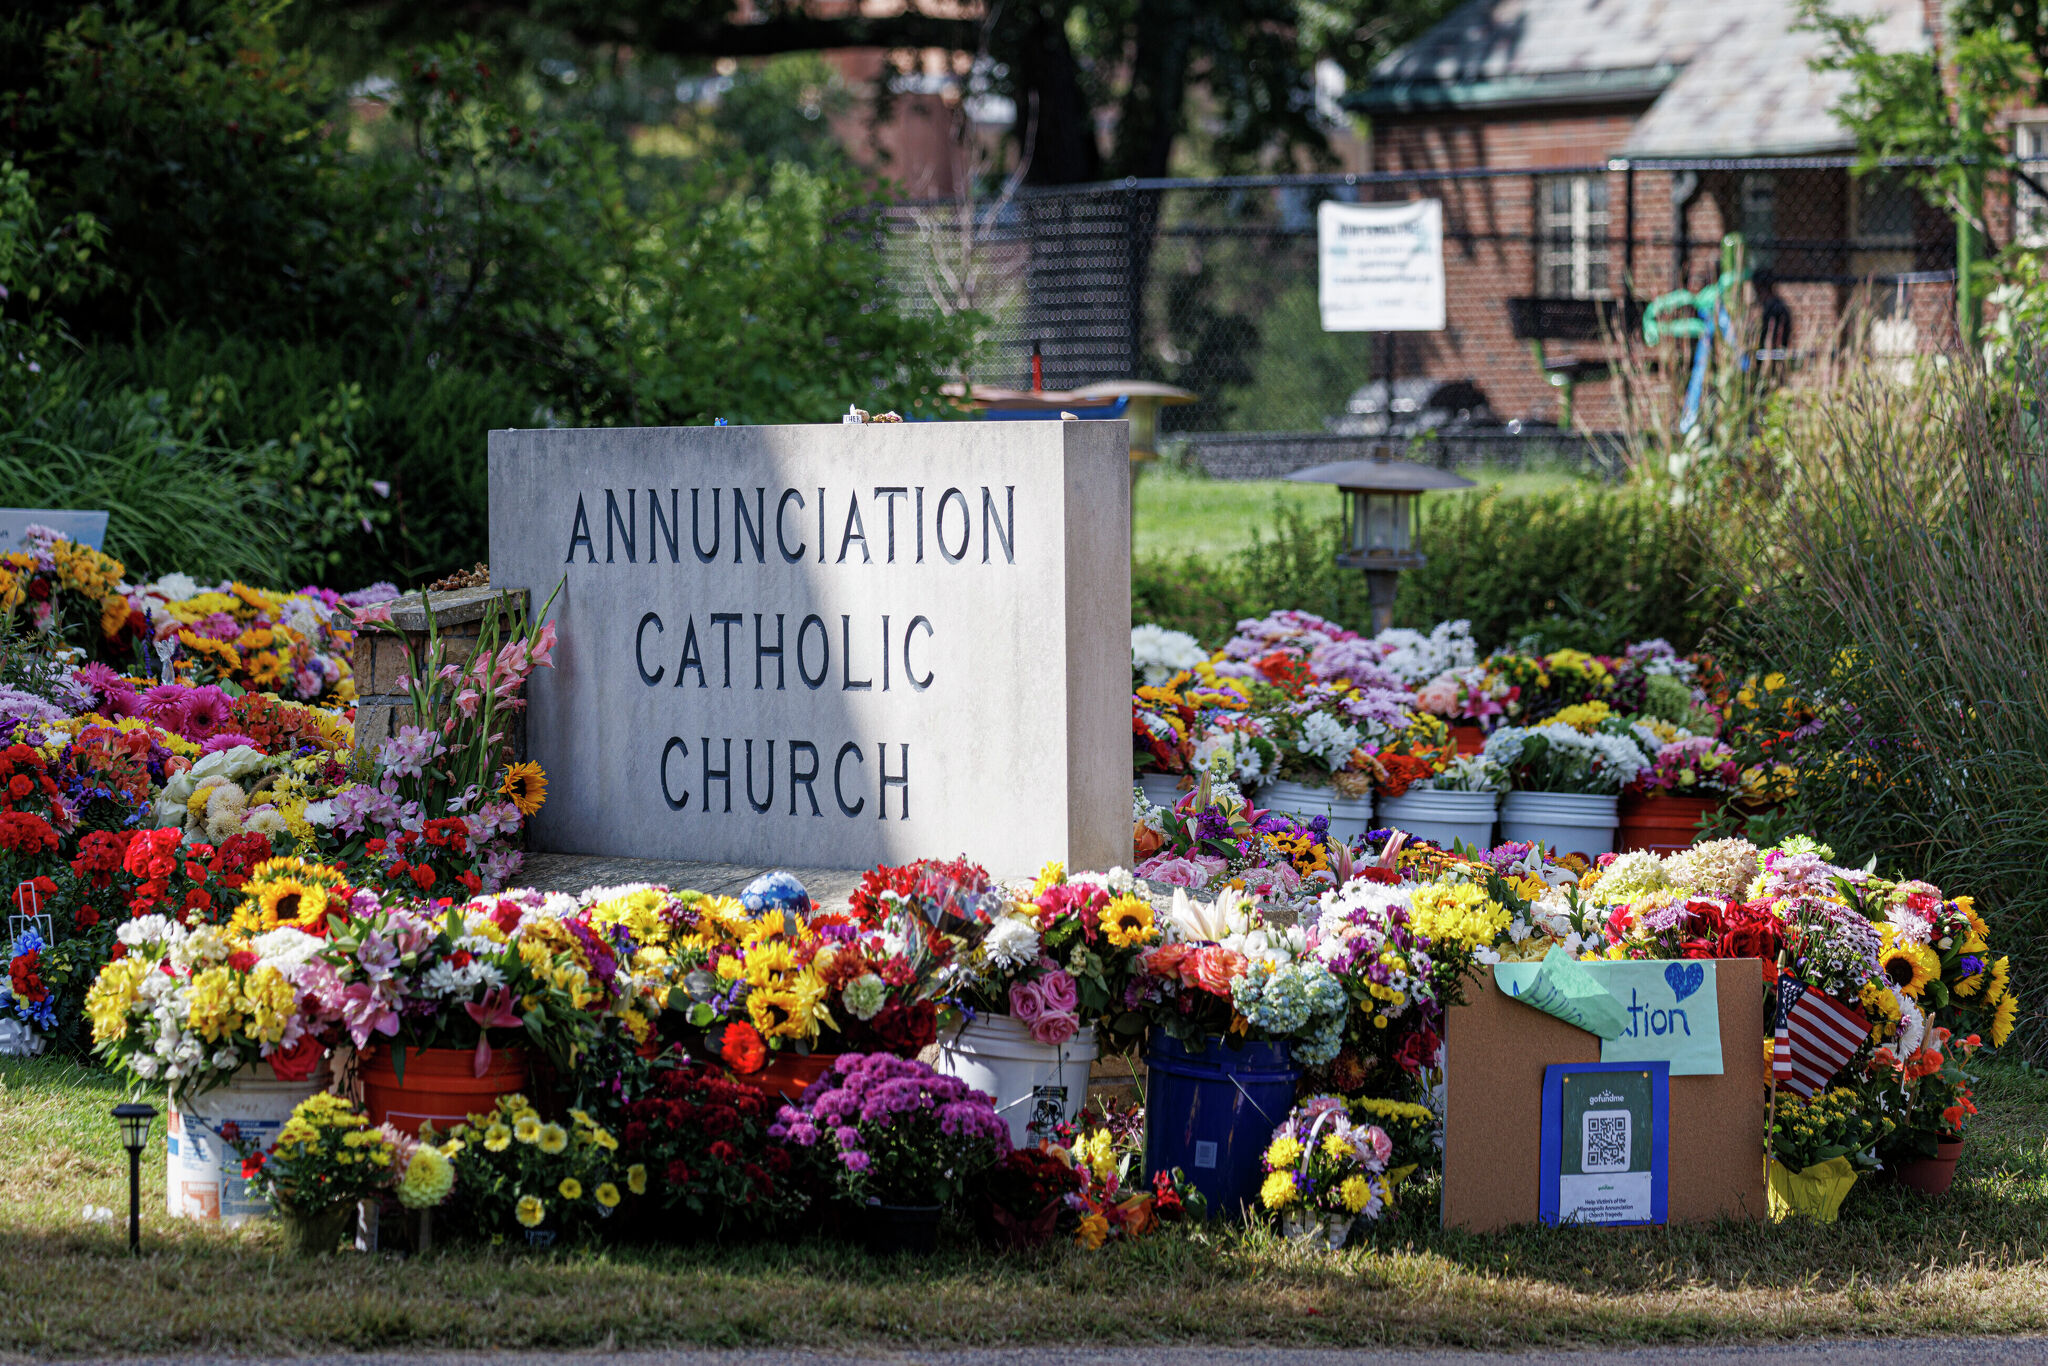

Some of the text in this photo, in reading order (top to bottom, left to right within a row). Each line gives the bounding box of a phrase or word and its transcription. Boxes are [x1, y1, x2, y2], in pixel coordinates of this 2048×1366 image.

[565, 486, 1016, 565] ANNUNCIATION
[635, 612, 935, 693] CATHOLIC
[660, 736, 910, 821] CHURCH
[1620, 987, 1691, 1038] tion
[1589, 1093, 1625, 1106] gofundme
